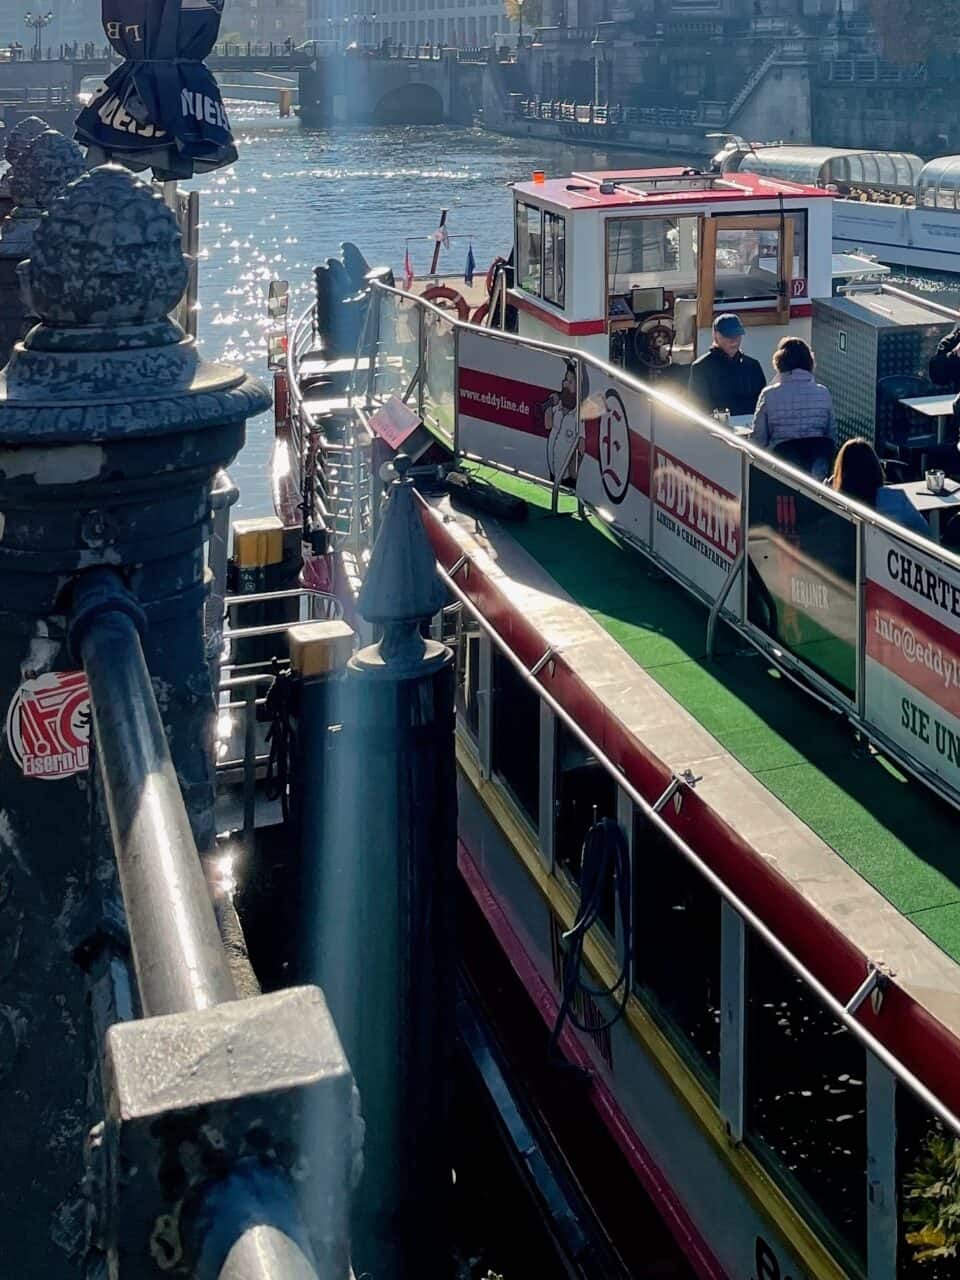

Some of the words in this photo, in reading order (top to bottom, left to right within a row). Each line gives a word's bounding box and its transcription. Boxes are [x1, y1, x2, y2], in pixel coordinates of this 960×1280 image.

[459, 387, 530, 416] www.eddyline.de
[656, 452, 738, 556] EDDYLINE
[901, 696, 930, 745] SIE
[23, 751, 75, 776] Eisern
